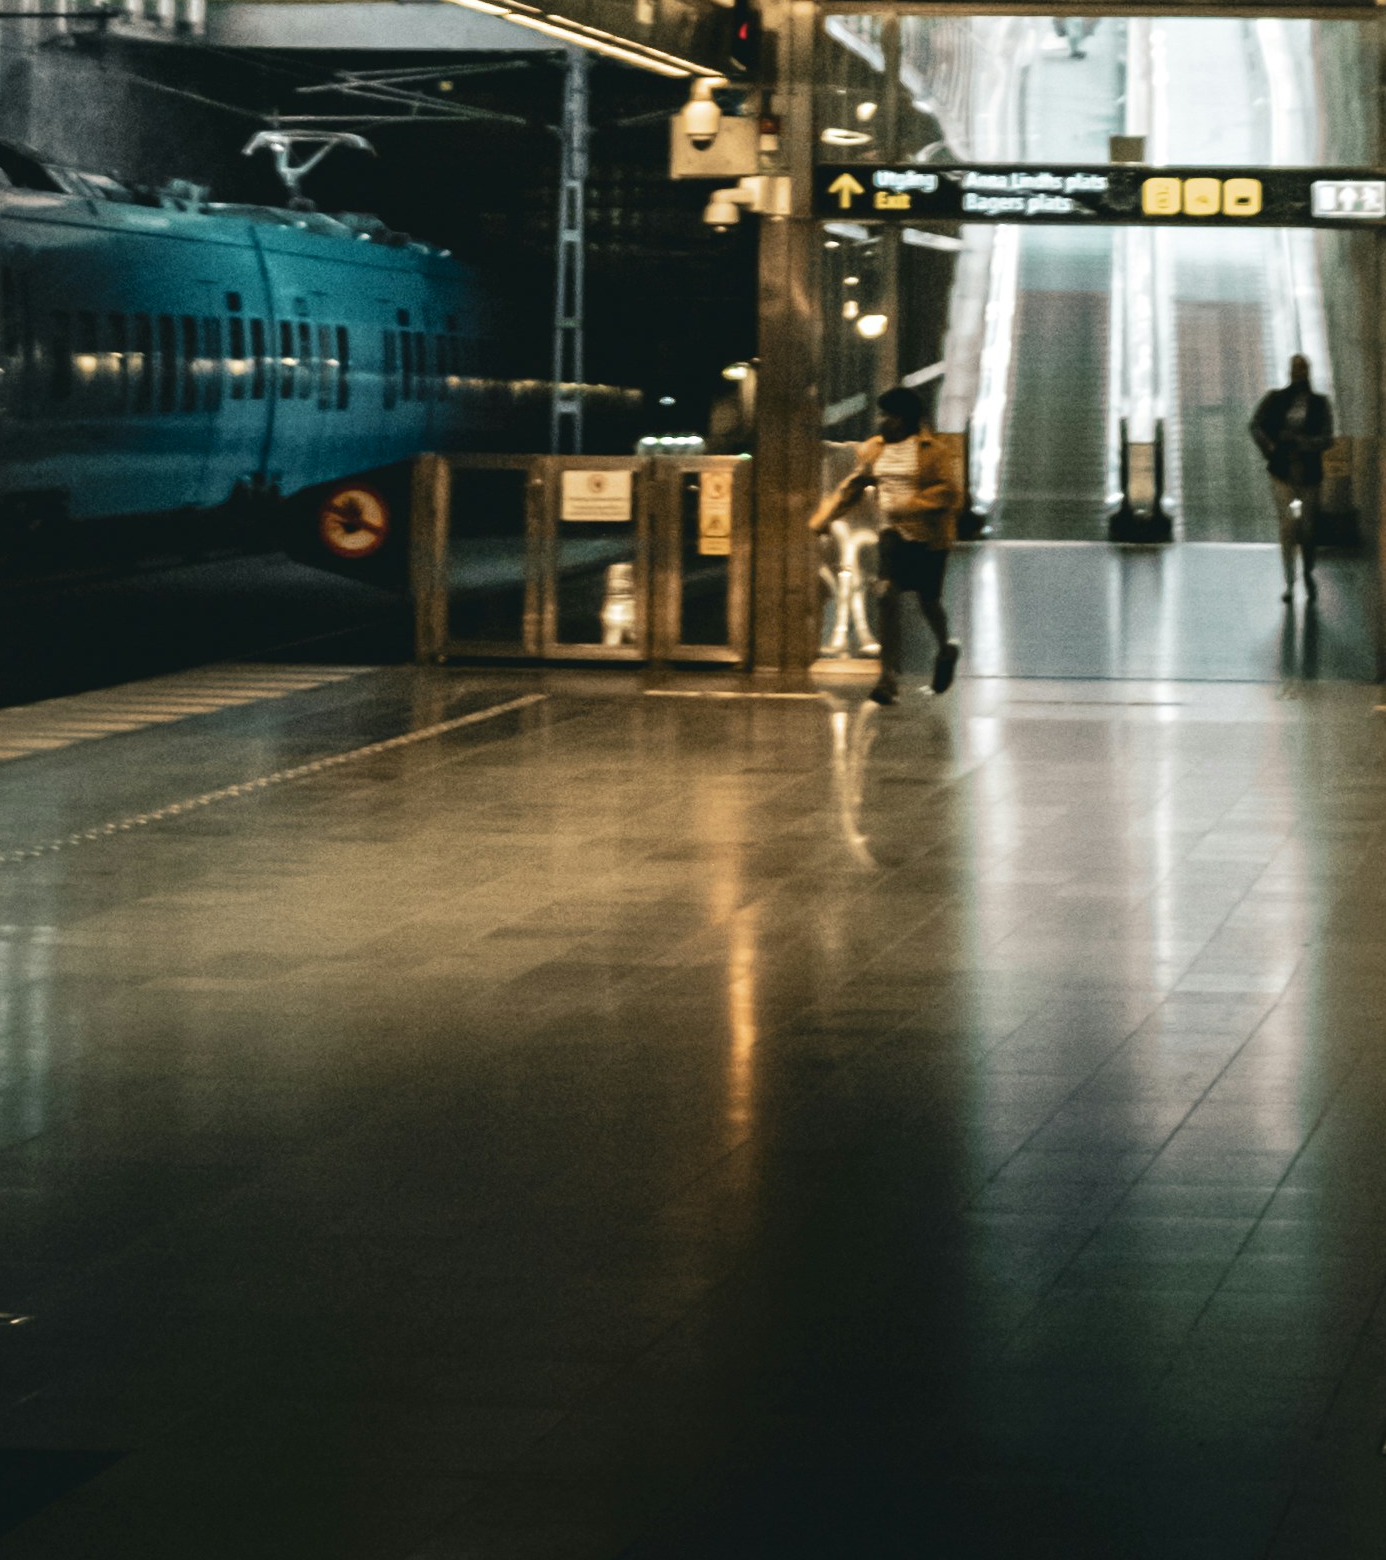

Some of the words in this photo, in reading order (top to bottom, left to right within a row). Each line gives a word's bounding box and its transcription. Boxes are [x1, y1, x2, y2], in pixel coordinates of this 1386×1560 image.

[1063, 172, 1109, 193] plats
[873, 191, 911, 210] Exit
[1026, 193, 1073, 216] plats
